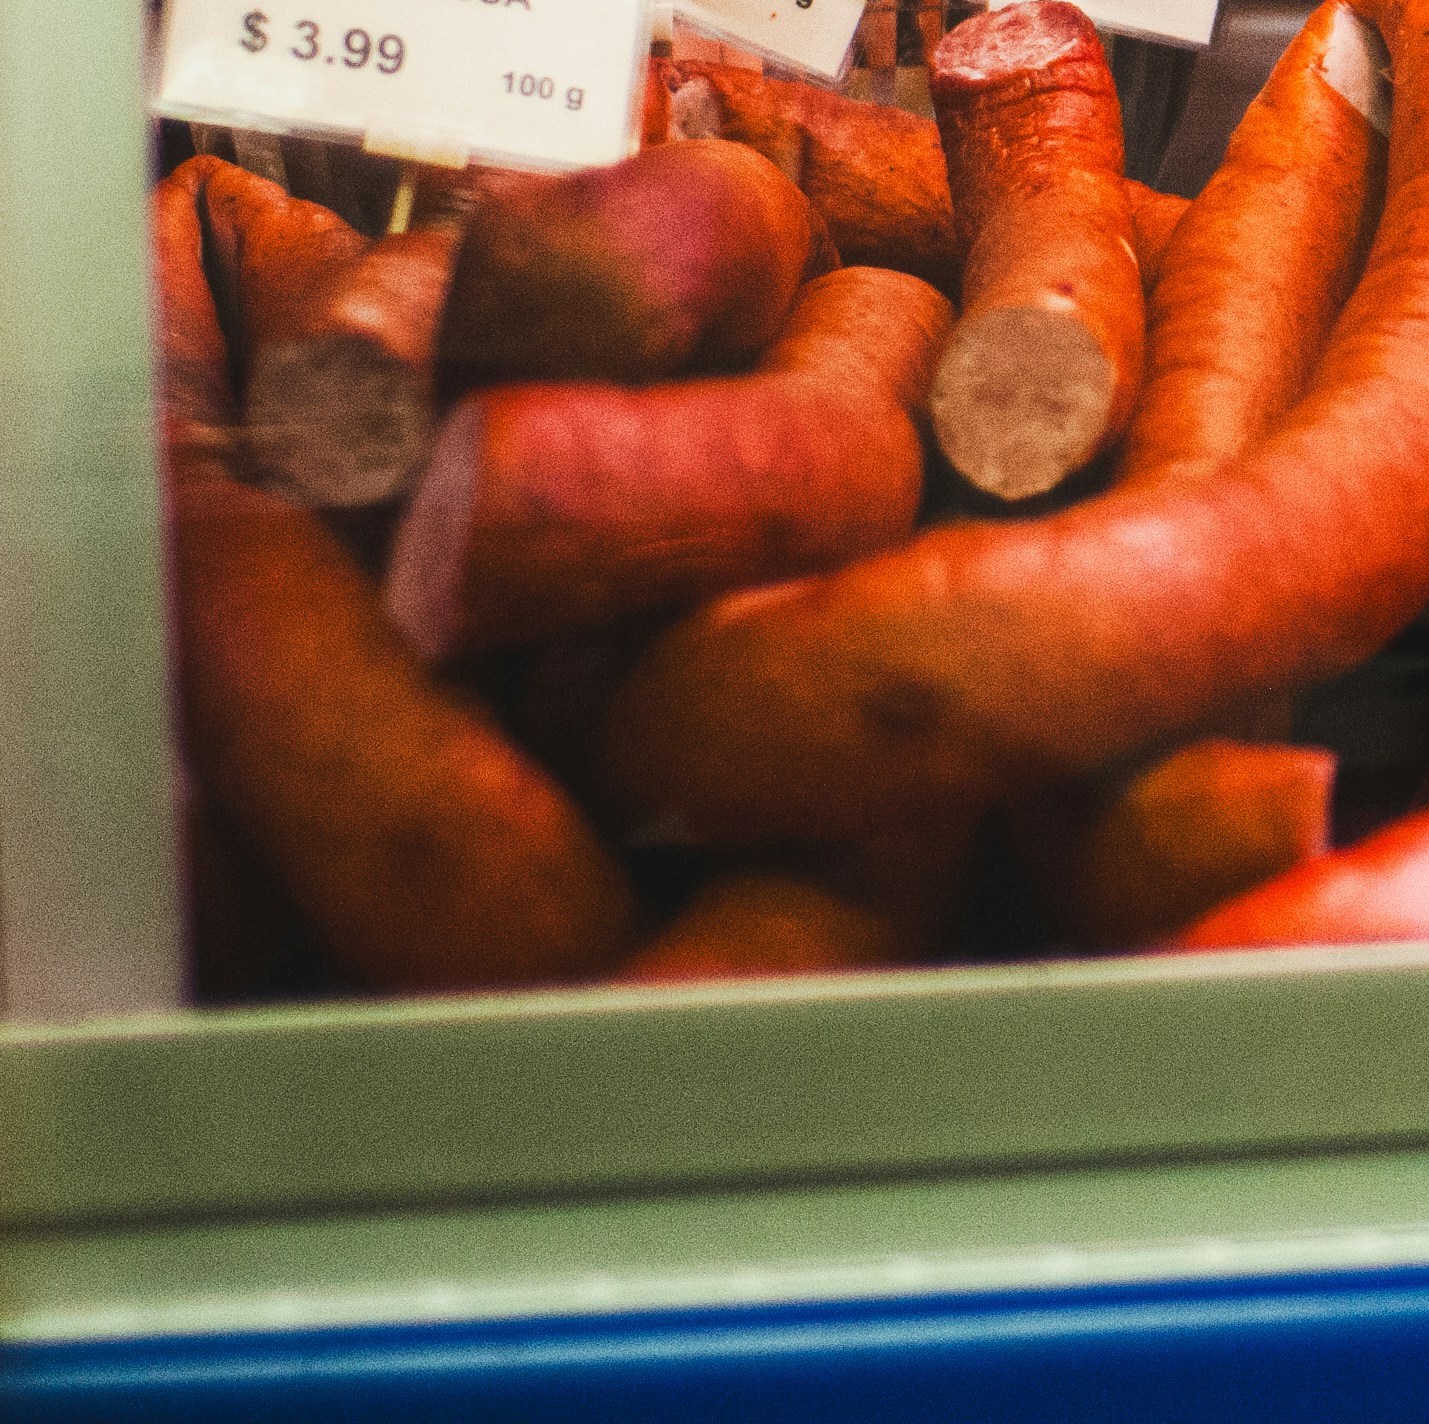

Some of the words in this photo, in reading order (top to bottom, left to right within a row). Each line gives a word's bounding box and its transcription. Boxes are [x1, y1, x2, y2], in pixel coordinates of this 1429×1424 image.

[238, 8, 269, 56] $
[291, 19, 406, 76] 3.99
[501, 70, 556, 101] 100
[565, 86, 585, 113] g
